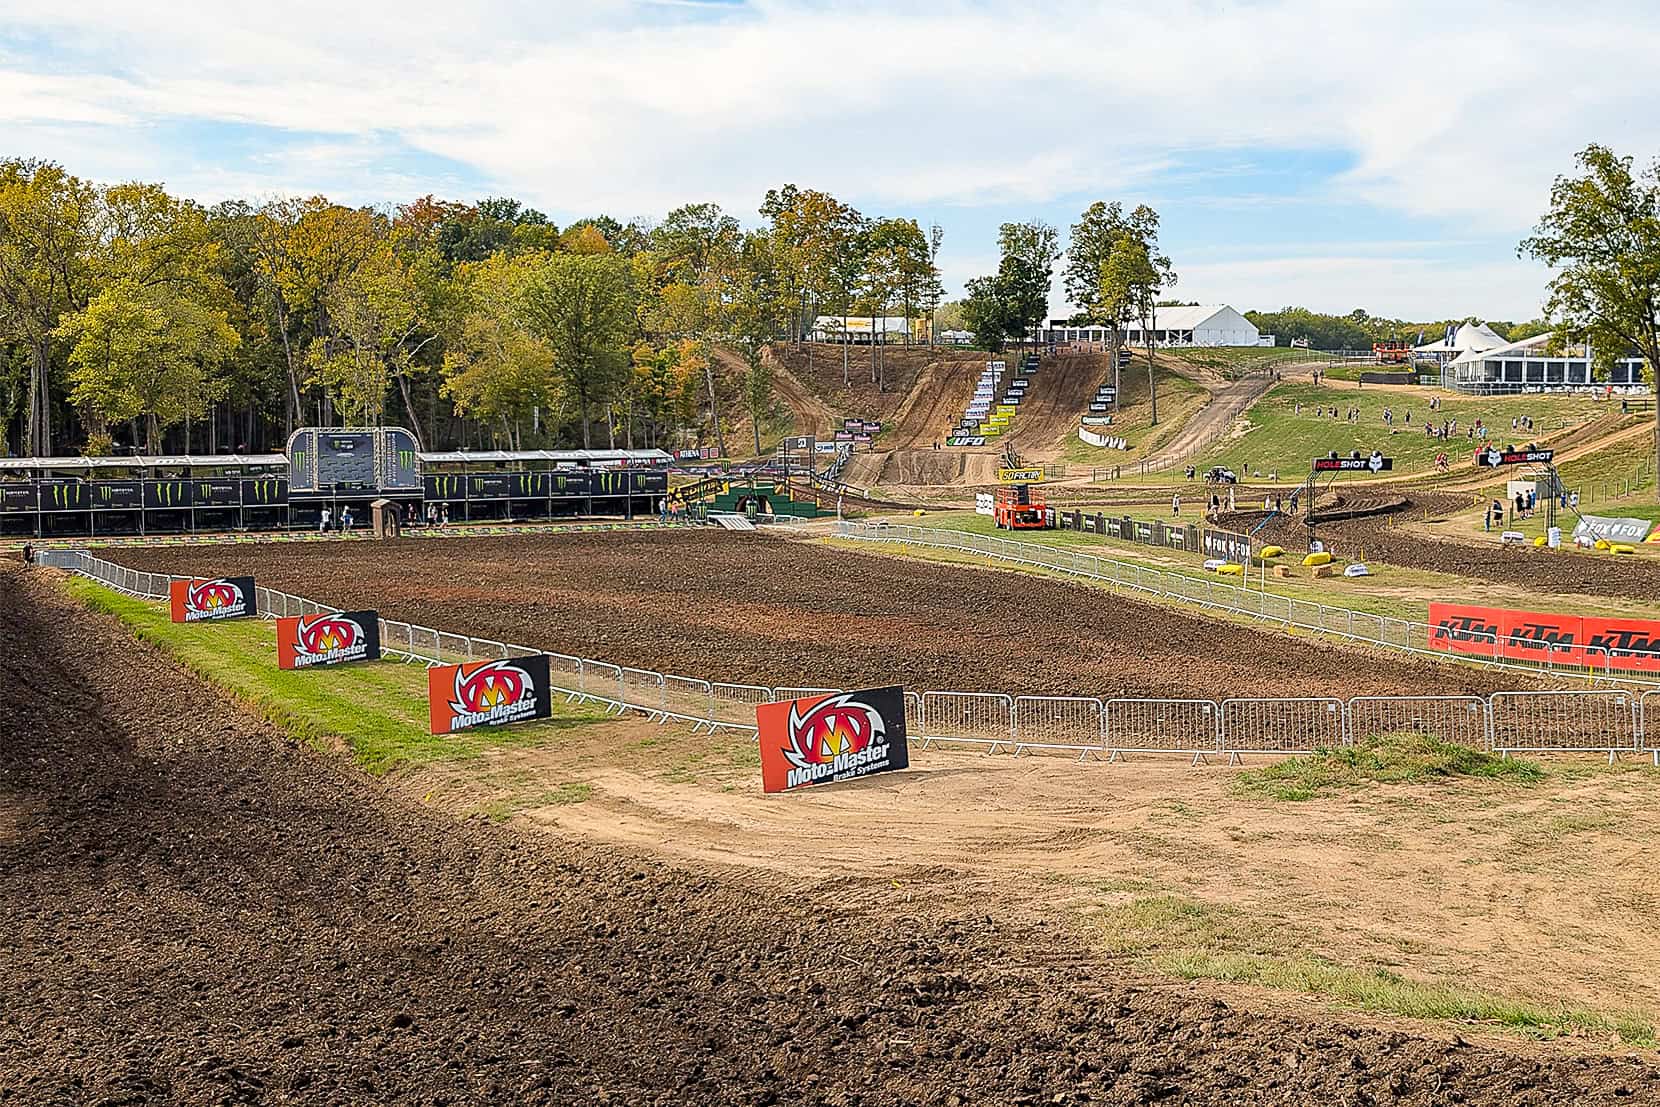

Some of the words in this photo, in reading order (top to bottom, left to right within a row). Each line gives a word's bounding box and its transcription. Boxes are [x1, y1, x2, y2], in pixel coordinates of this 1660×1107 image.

[953, 437, 985, 446] UFO
[680, 449, 700, 459] ATHENA
[1504, 452, 1552, 462] HOLESHOT
[1317, 460, 1367, 469] HOLESHOT
[1588, 520, 1612, 535] FOX
[1620, 524, 1645, 538] FOX
[1212, 535, 1227, 554] FOX
[1235, 541, 1251, 557] FOX
[1435, 615, 1498, 645] KTM
[1508, 623, 1575, 653] KTM
[1586, 630, 1660, 659] KTM
[833, 767, 856, 782] Brake
[857, 759, 890, 775] Systems
